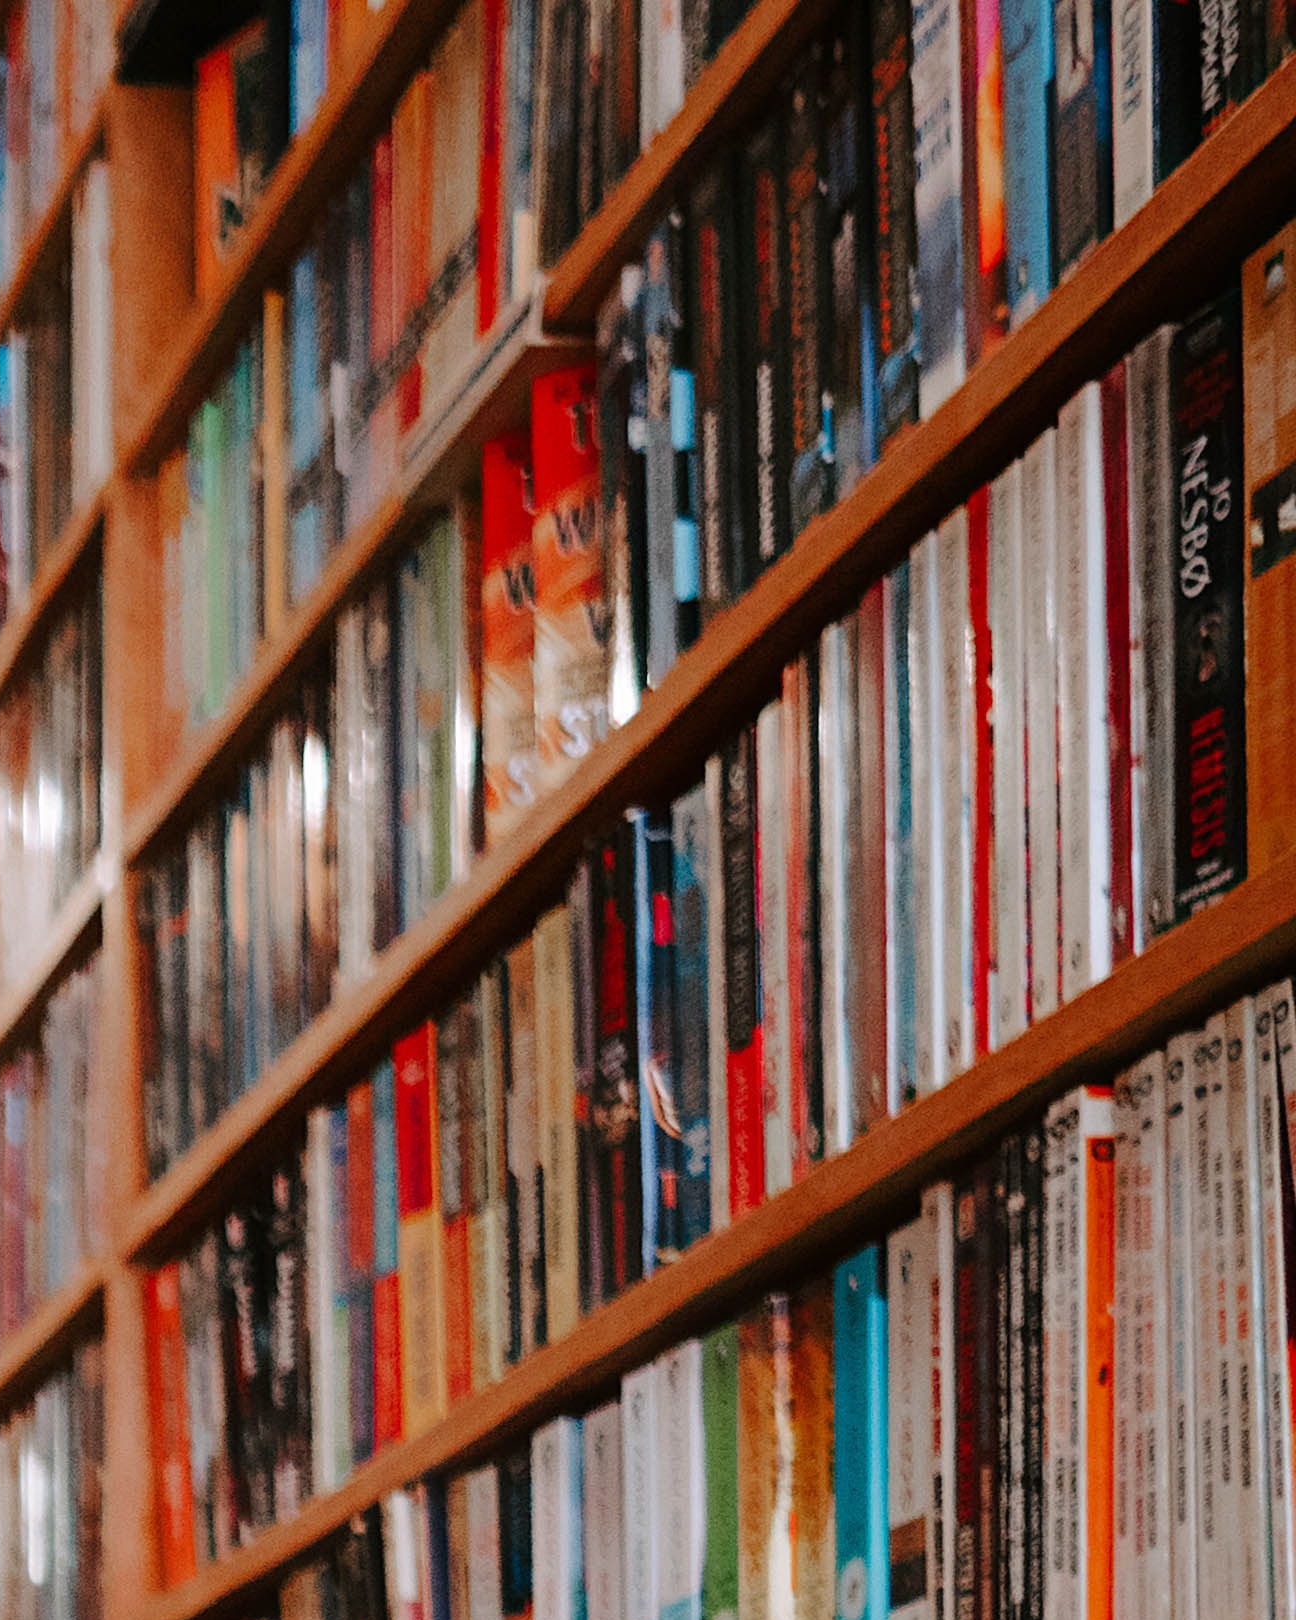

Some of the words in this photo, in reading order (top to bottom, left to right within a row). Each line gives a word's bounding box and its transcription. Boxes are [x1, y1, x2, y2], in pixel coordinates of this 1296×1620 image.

[1180, 434, 1212, 599] NESBØ
[1209, 478, 1231, 522] JO
[1190, 707, 1226, 858] NEMESIS
